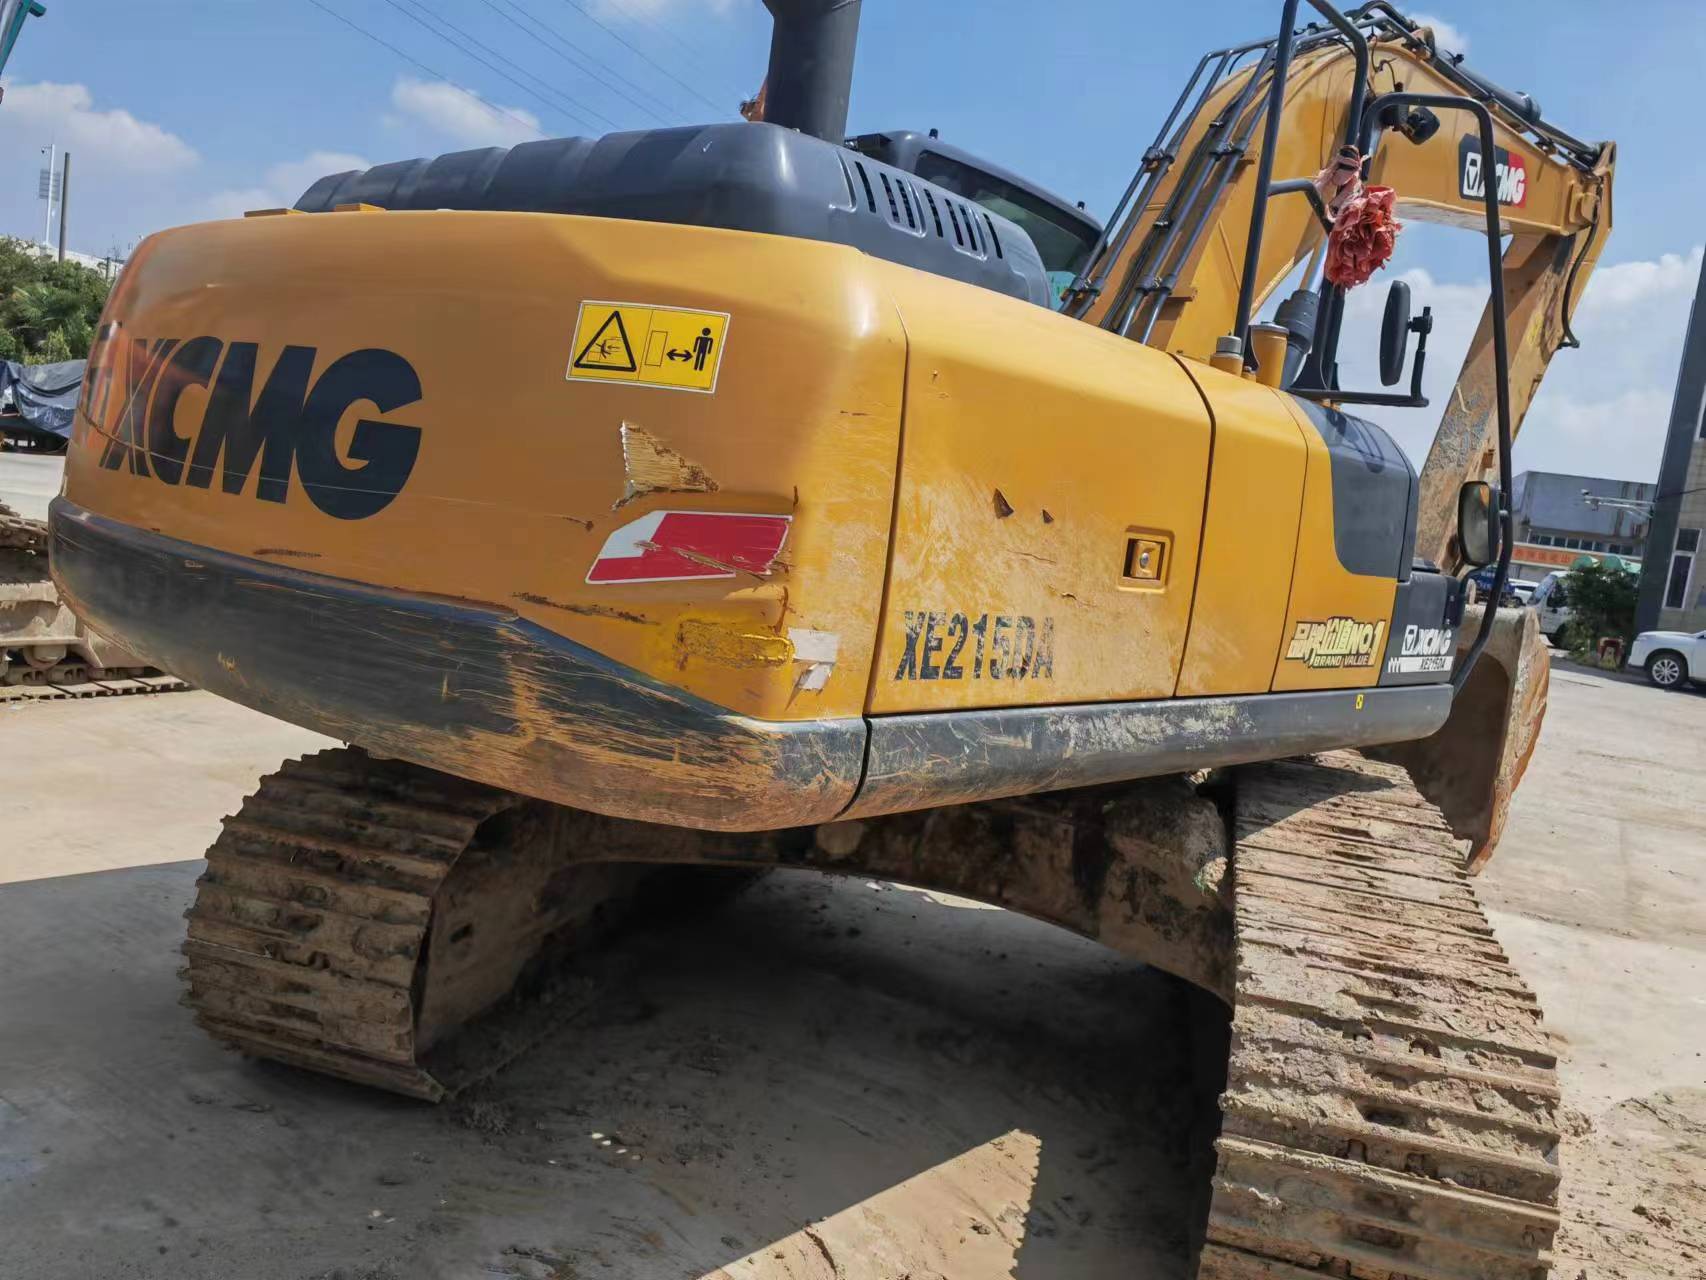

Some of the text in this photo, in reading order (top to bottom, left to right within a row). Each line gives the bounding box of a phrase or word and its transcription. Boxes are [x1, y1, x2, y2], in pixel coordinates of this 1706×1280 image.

[100, 335, 423, 521] XCMG
[894, 610, 1055, 681] XE215DA
[1313, 654, 1369, 667] BRAND VALUE
